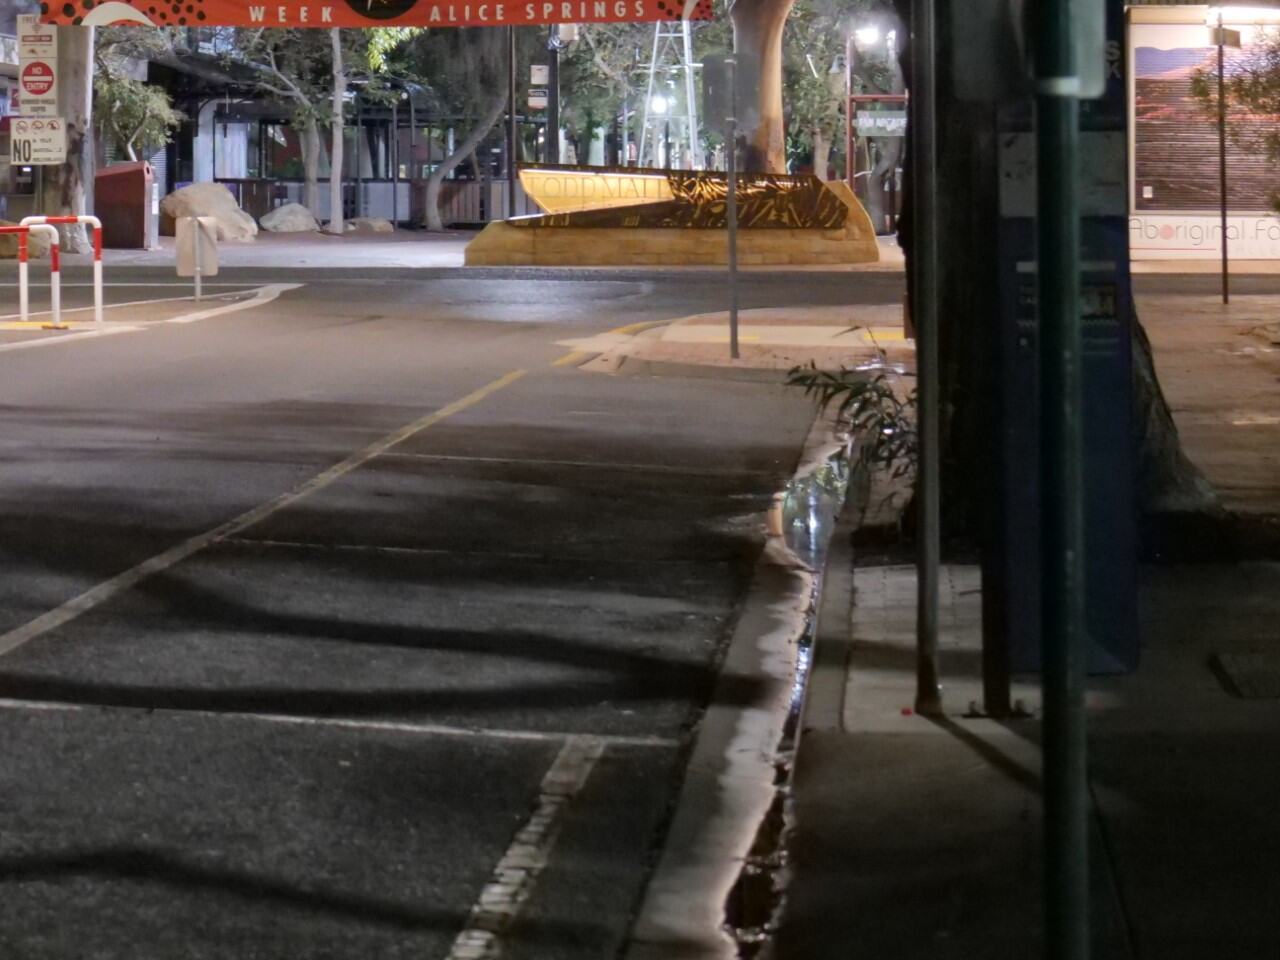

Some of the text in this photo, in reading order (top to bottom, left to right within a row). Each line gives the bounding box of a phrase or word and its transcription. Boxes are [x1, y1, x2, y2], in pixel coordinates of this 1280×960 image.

[249, 0, 644, 22] WEEK ALICE SPRINGS
[13, 138, 31, 162] NO
[525, 177, 596, 198] TODD
